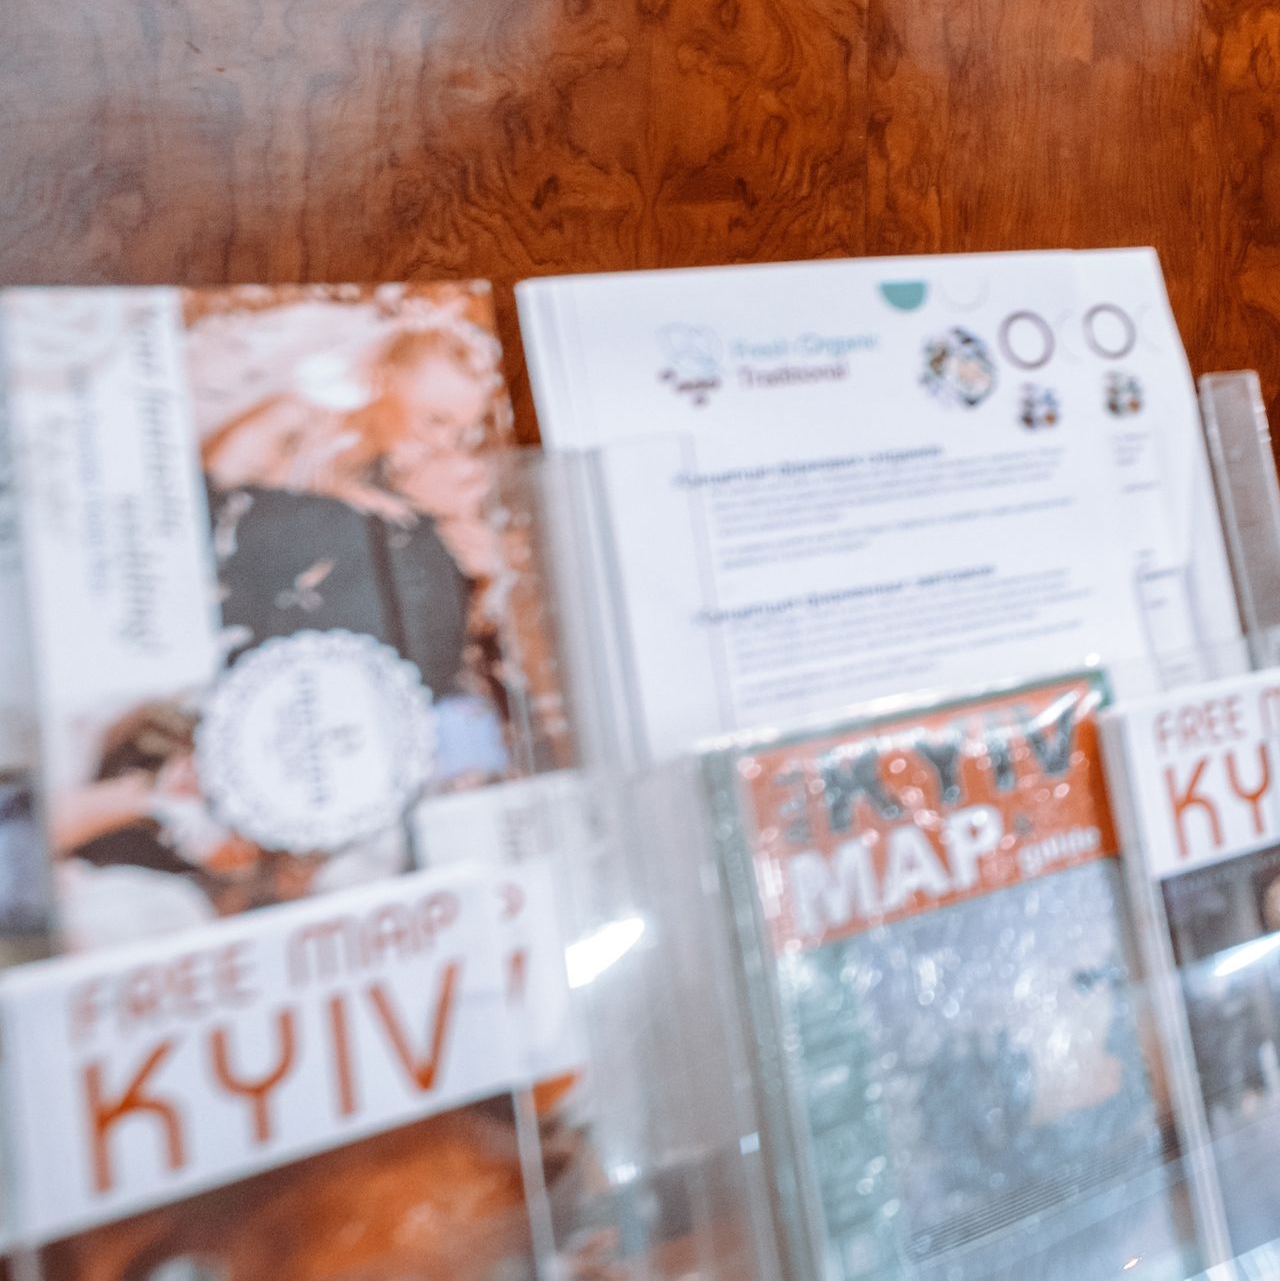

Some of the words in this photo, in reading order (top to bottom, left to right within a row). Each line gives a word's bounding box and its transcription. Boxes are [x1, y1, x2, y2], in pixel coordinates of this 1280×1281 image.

[1154, 693, 1246, 756] FREE
[789, 805, 1004, 938] MAP
[66, 938, 260, 1049] FREE
[287, 892, 459, 990] MAP
[84, 961, 461, 1194] KYIV
